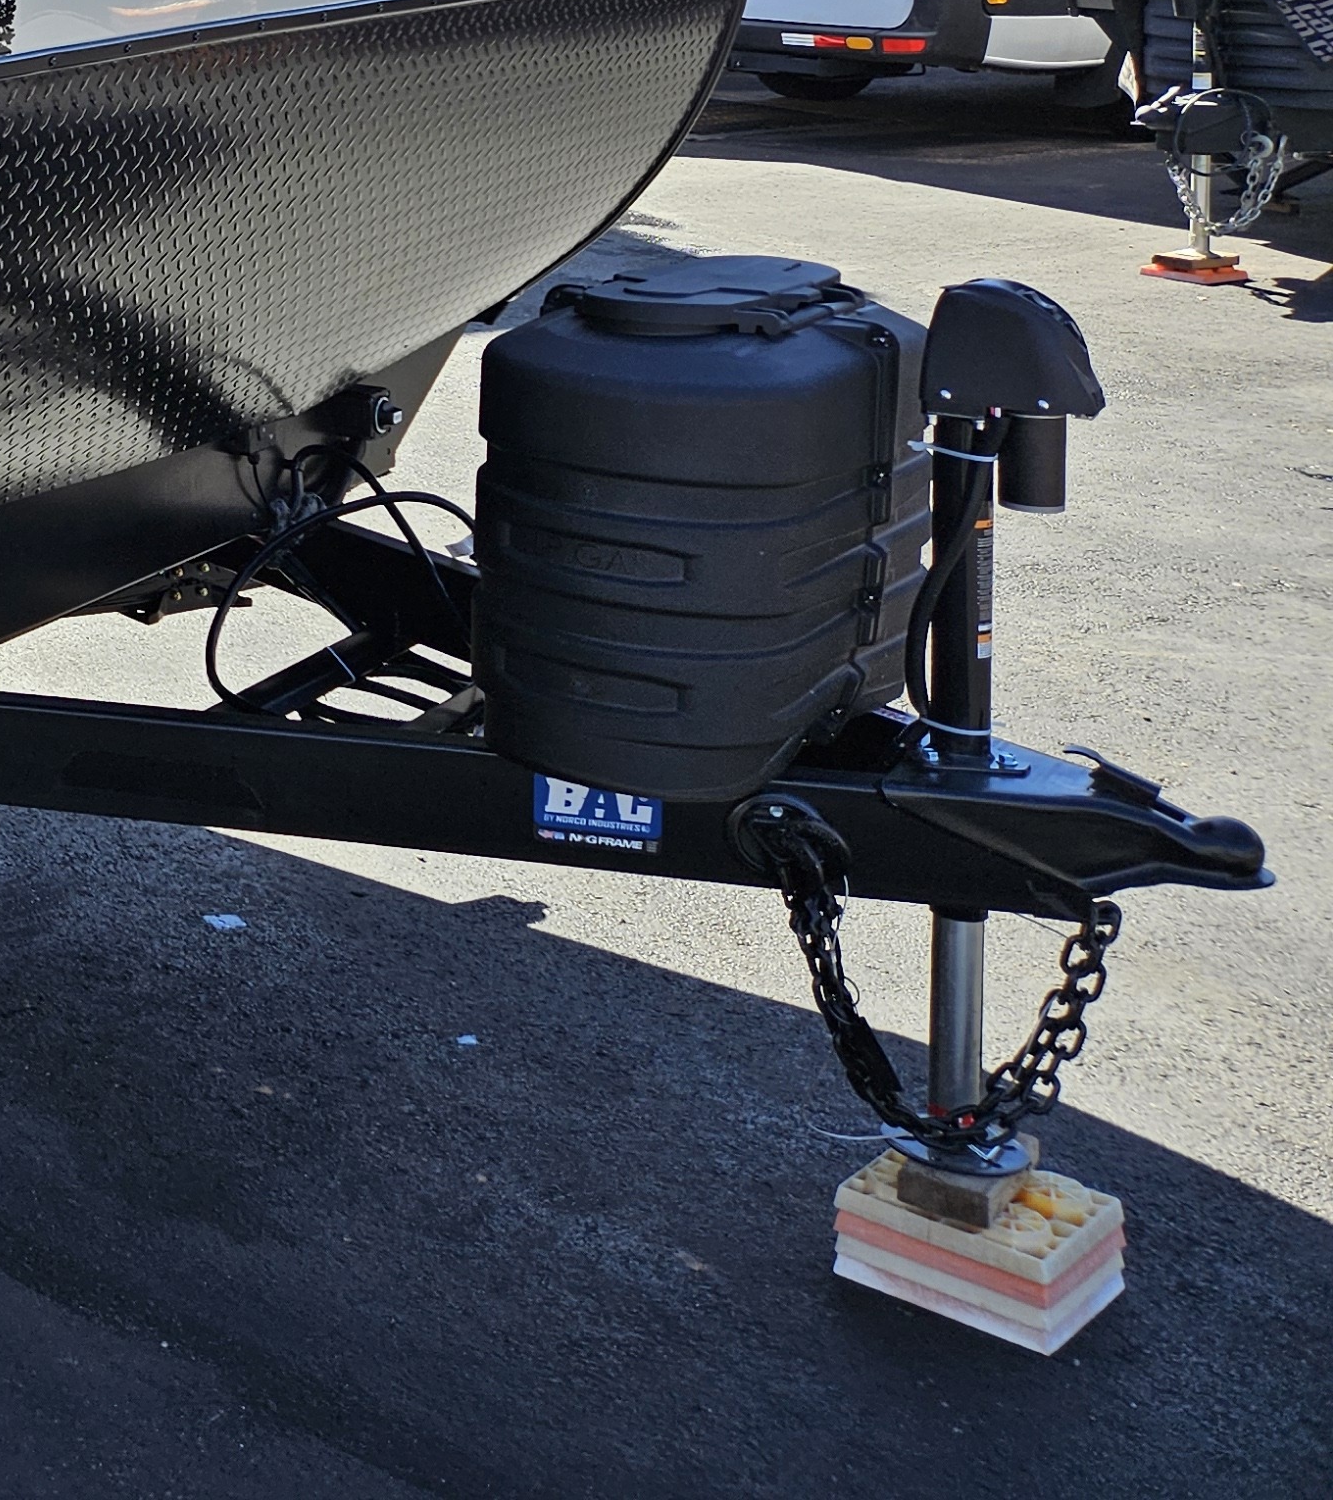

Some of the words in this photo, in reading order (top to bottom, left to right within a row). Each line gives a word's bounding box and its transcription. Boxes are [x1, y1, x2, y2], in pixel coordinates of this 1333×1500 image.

[543, 813, 554, 822] BY
[555, 814, 587, 826] NORCO
[588, 818, 641, 833] INDUSTRIES
[598, 835, 643, 850] FRAME
